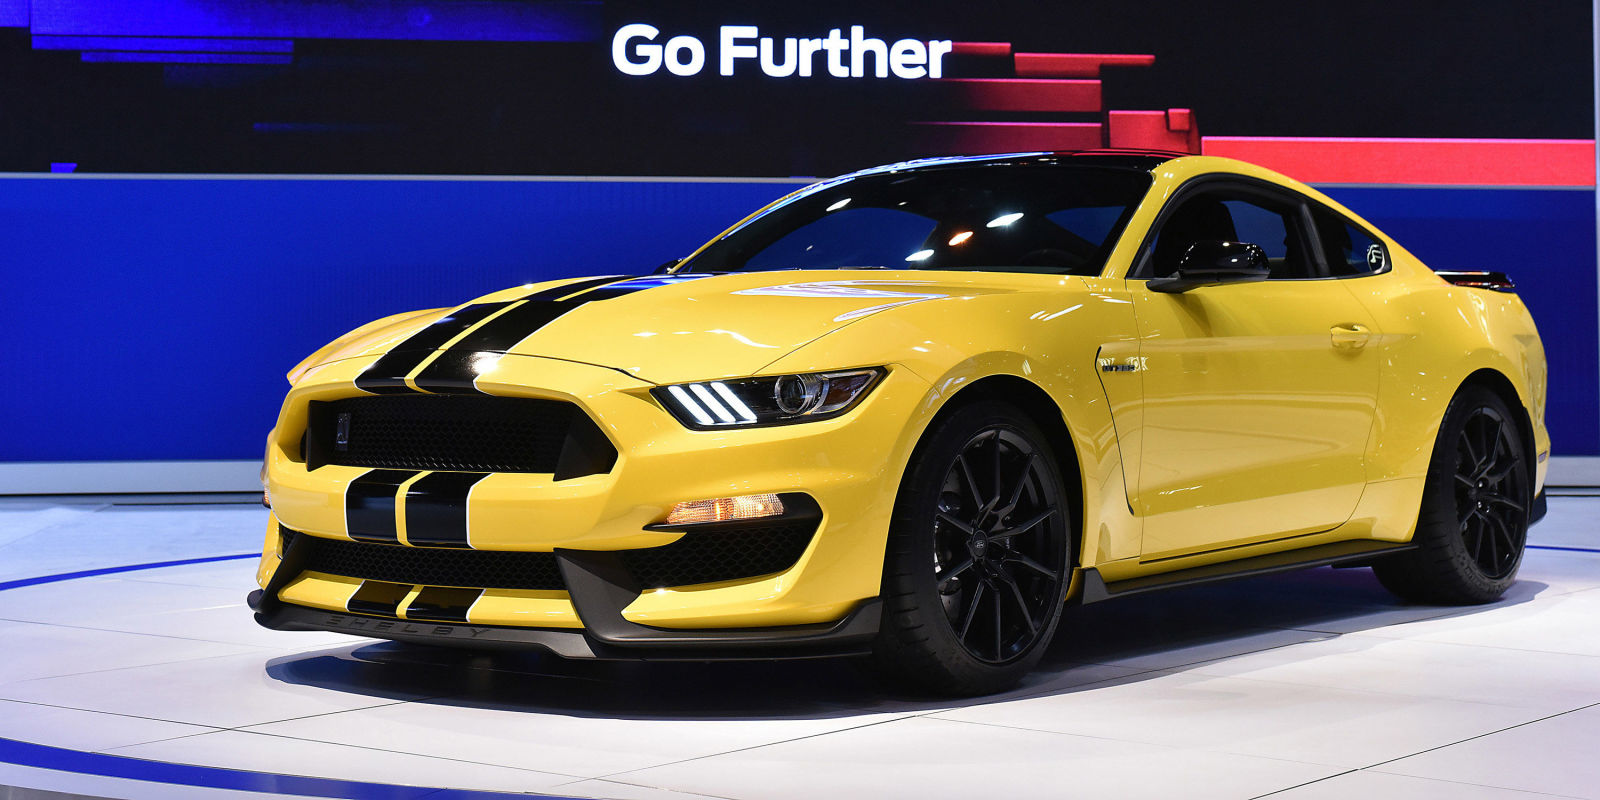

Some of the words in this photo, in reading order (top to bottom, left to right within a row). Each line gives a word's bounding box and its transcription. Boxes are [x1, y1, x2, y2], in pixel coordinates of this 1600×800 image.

[611, 23, 706, 77] Go
[719, 24, 953, 79] Further
[326, 615, 490, 638] SHELBY
